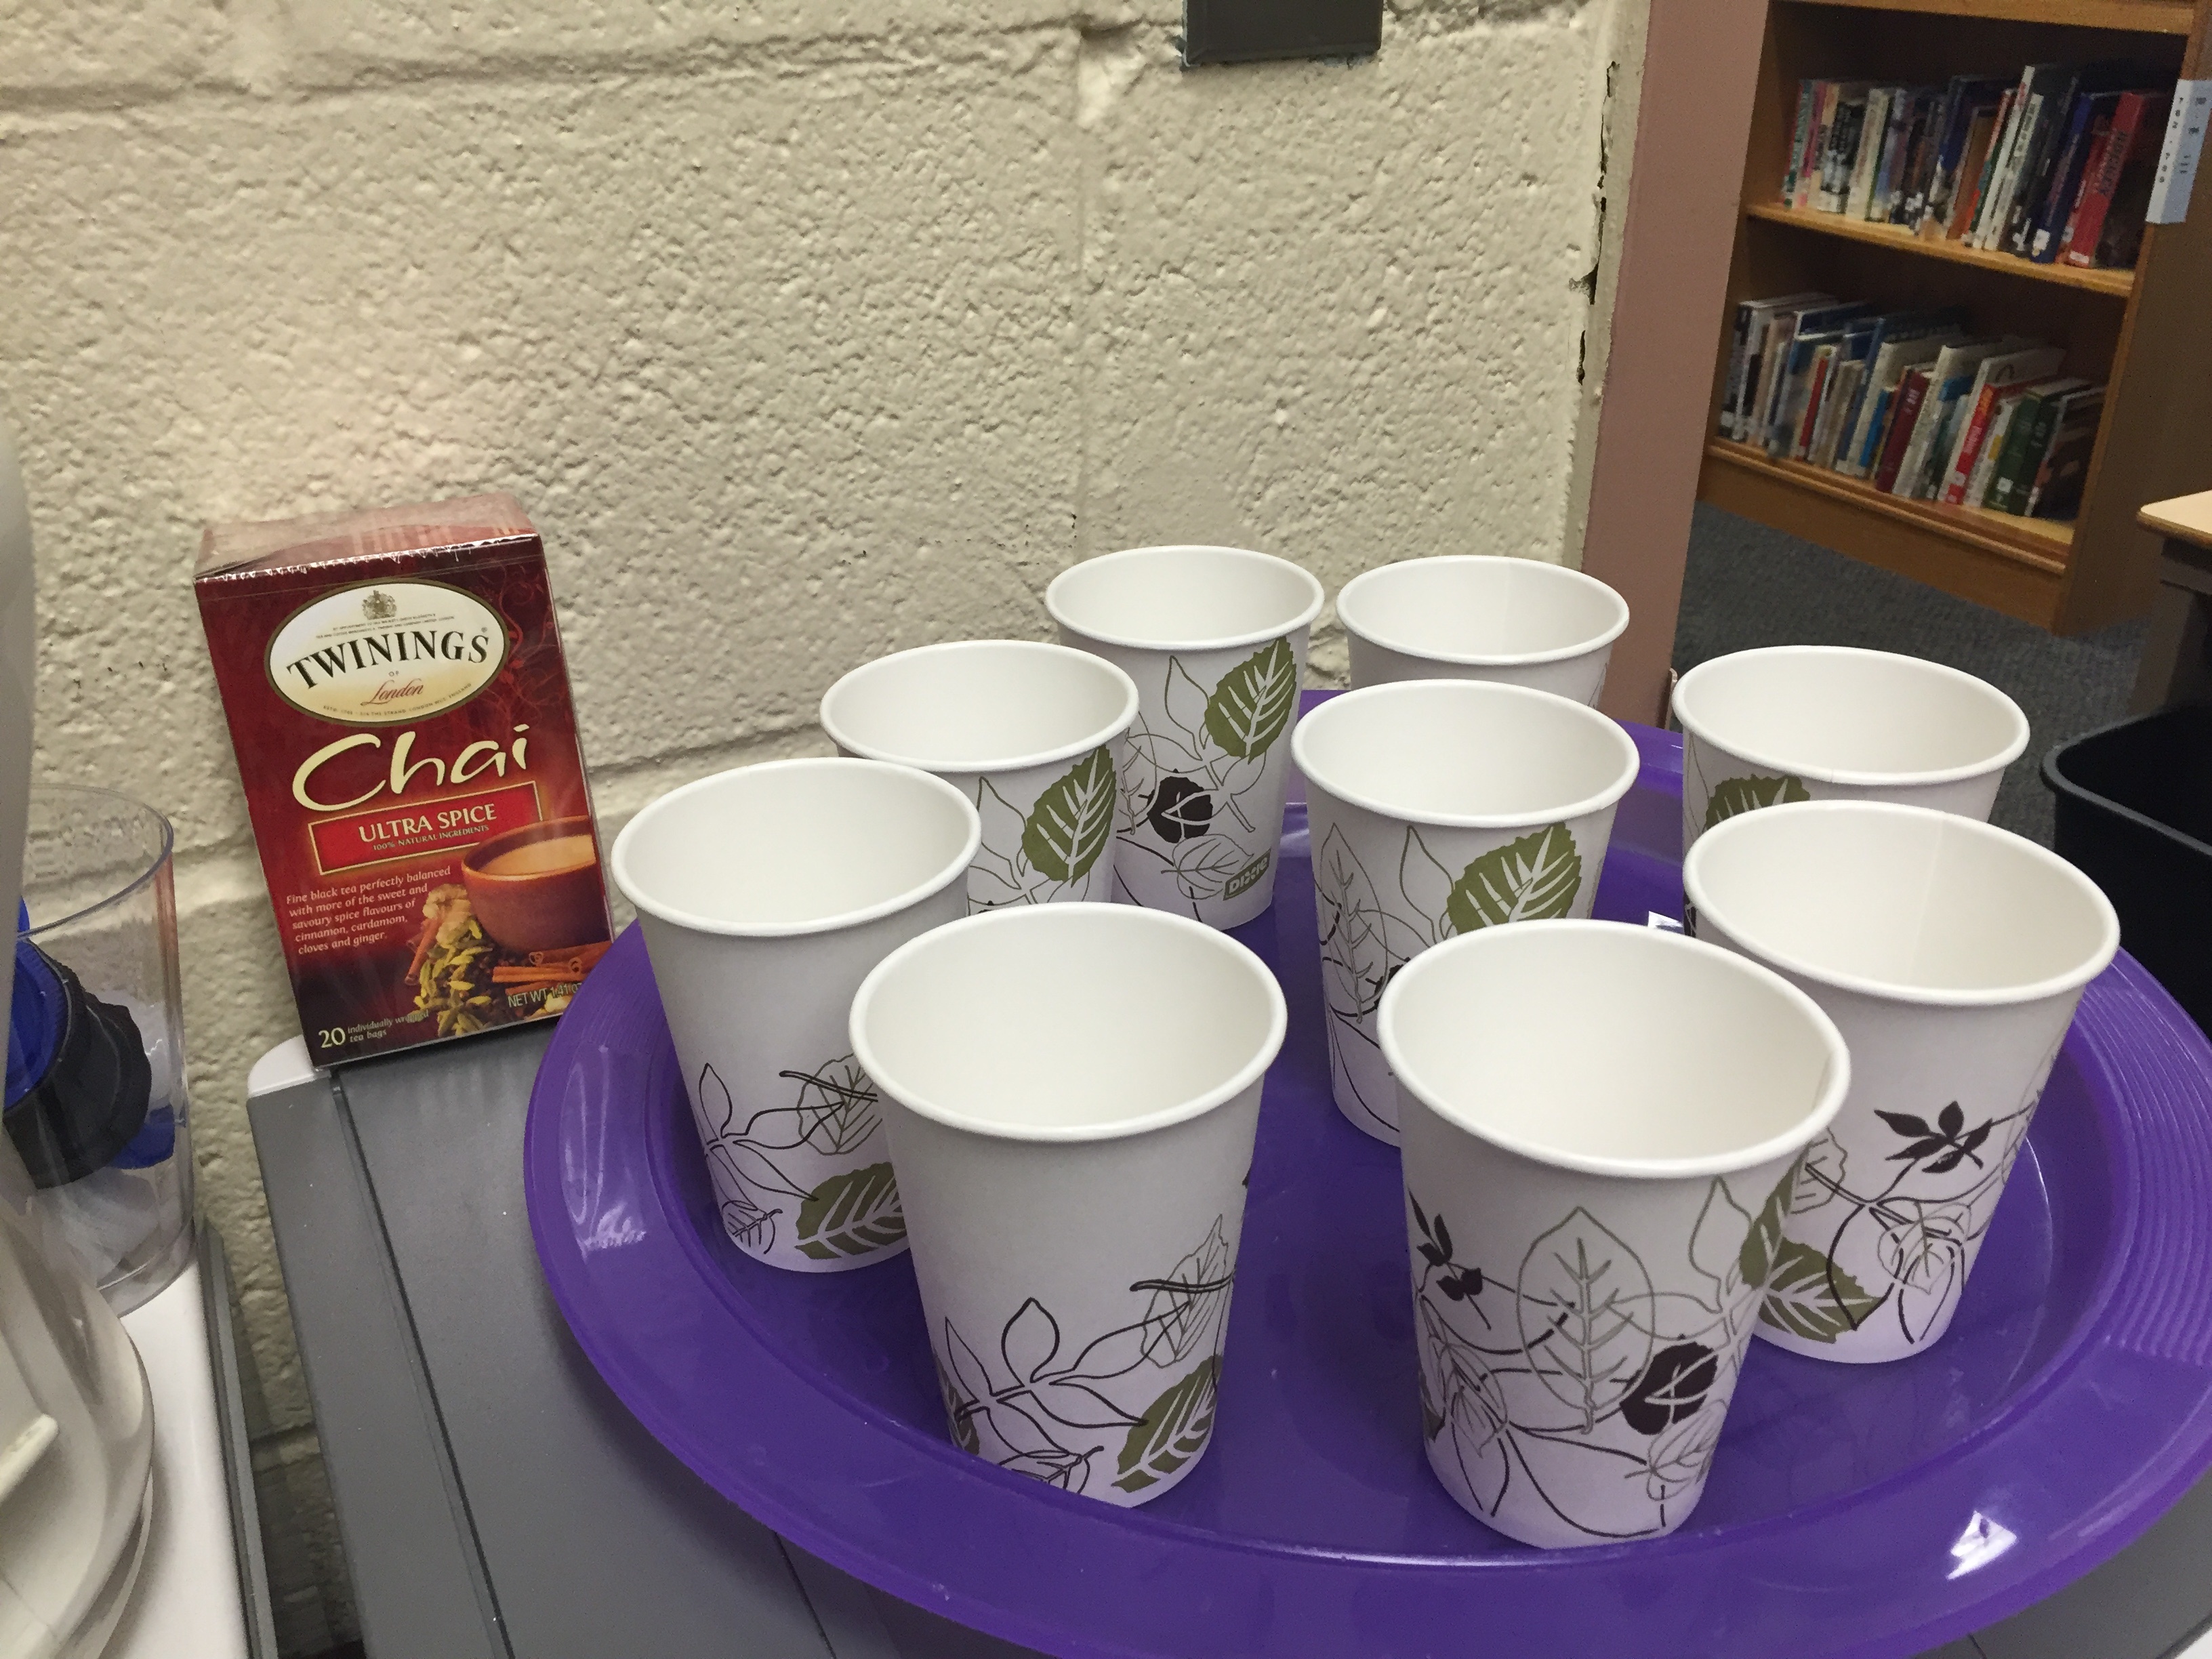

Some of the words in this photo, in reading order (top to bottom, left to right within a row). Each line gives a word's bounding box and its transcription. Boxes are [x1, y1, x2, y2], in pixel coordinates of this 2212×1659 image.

[286, 630, 489, 689] TWININGS
[361, 678, 424, 705] London
[292, 724, 530, 811] Chai
[359, 815, 433, 843] ULTRA
[437, 803, 497, 830] SPICE
[373, 842, 396, 851] 100%
[398, 833, 438, 846] NATURAL
[439, 825, 489, 839] INGREDIENTS
[286, 895, 308, 905] Fine
[310, 888, 337, 901] black
[341, 884, 356, 895] tea
[360, 875, 404, 894] perfectly
[407, 865, 451, 882] balanced
[289, 905, 312, 918] with
[316, 901, 342, 913] more
[345, 897, 356, 907] of
[359, 893, 374, 905] the
[377, 888, 406, 901] sweet
[409, 883, 428, 895] and
[292, 916, 332, 930] savoury
[334, 911, 360, 924] spice
[363, 903, 403, 917] flavours
[405, 898, 416, 909] of
[295, 926, 349, 943] cinnamon,
[351, 916, 408, 933] cardamom,
[298, 941, 329, 956] cloves
[331, 935, 350, 948] and
[508, 992, 529, 1008] NET
[530, 987, 548, 1003] WT
[318, 1027, 346, 1048] 20
[348, 1018, 393, 1034] individually
[350, 1034, 364, 1043] tea
[367, 1029, 387, 1039] bags
